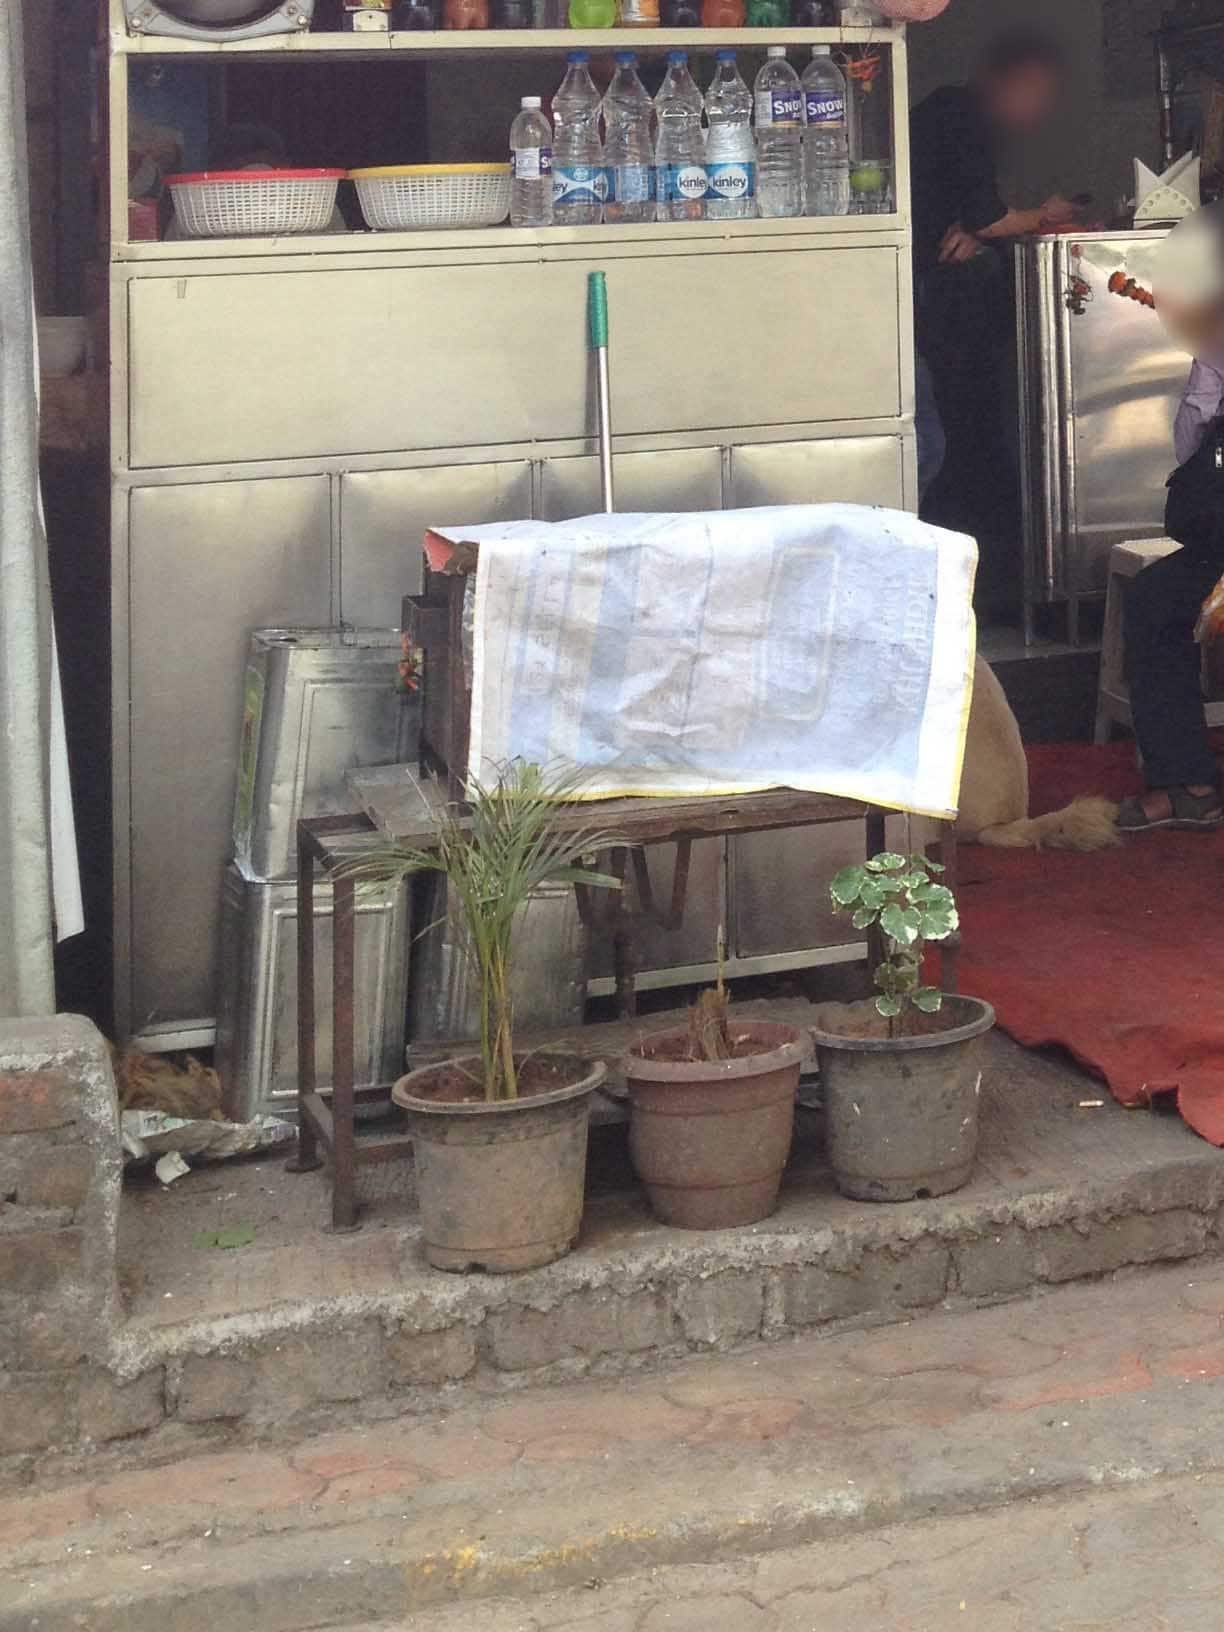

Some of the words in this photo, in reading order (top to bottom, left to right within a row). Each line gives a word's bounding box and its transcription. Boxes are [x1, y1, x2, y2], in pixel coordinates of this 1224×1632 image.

[774, 100, 800, 115] SNO
[679, 176, 706, 188] kinle
[713, 175, 745, 189] kinley
